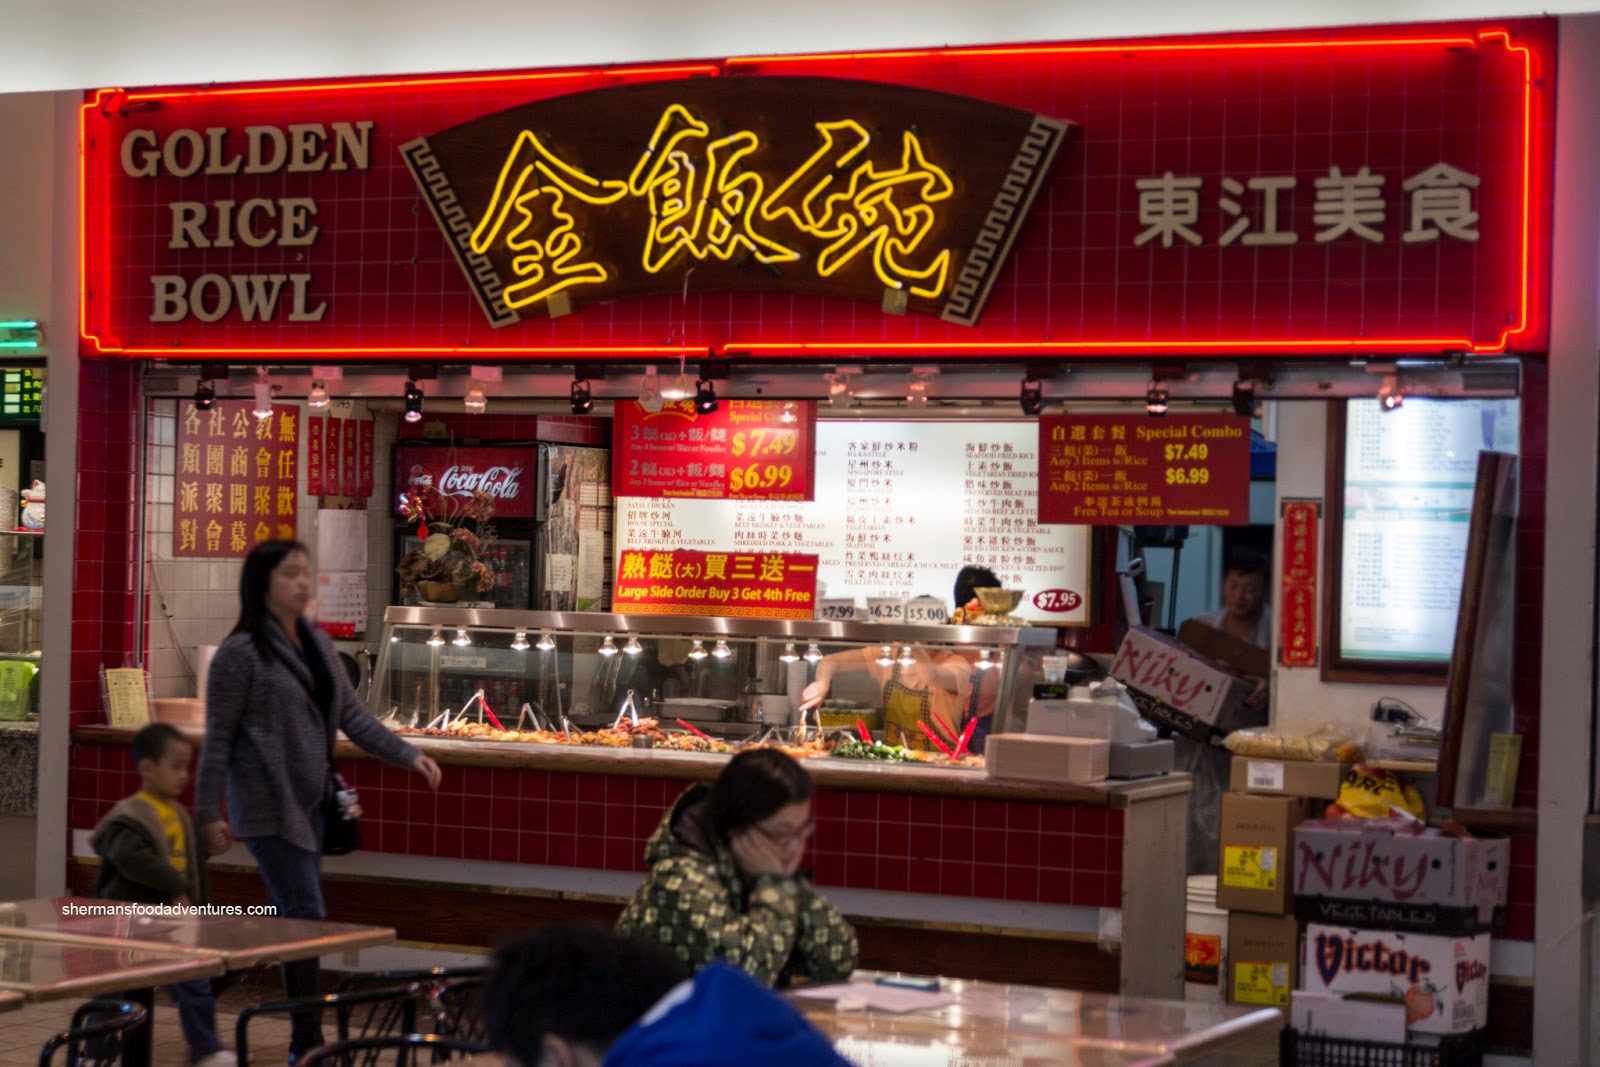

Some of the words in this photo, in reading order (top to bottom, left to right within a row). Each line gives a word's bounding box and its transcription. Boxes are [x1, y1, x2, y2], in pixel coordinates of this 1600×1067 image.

[120, 120, 374, 178] GOLDEN
[469, 103, 953, 309] 金飯碗
[1134, 162, 1481, 248] 東江美食
[168, 197, 319, 249] RICE
[150, 273, 327, 322] BOWL
[730, 410, 762, 424] Special
[630, 424, 640, 440] 3
[732, 428, 796, 456] $7.49
[1052, 425, 1126, 441] 自選套餐
[1136, 426, 1187, 441] Special
[1192, 425, 1242, 438] Combo
[966, 442, 1013, 452] 海鮮炒飯
[1164, 444, 1208, 460] $7.49
[1050, 457, 1072, 468] Any
[1074, 456, 1080, 465] 3
[1082, 456, 1110, 466] Items
[205, 406, 226, 552] 社團聚會
[439, 465, 524, 499] Coca-Cola
[629, 459, 638, 476] 2
[729, 464, 792, 492] $6.99
[1166, 468, 1210, 485] $6.99
[1050, 482, 1072, 493] Any
[1074, 482, 1080, 490] 2
[1082, 482, 1110, 491] Items
[1074, 507, 1098, 516] Free
[1100, 508, 1120, 516] Tea
[1136, 508, 1164, 518] Soup
[618, 585, 648, 599] Large
[650, 585, 673, 598] Side
[676, 586, 707, 599] Order
[709, 586, 730, 602] Buy
[732, 588, 739, 599] 3
[742, 588, 762, 600] Get
[764, 588, 783, 600] 4th
[785, 588, 810, 601] Free
[1037, 592, 1076, 609] $7.95
[822, 605, 854, 618] $7.99
[870, 605, 902, 617] $6.25
[910, 608, 944, 620] $5.00
[1112, 640, 1206, 706] Niky
[1297, 840, 1428, 901] Niky
[1320, 902, 1436, 922] VEGETABLES
[1314, 931, 1432, 988] Victor
